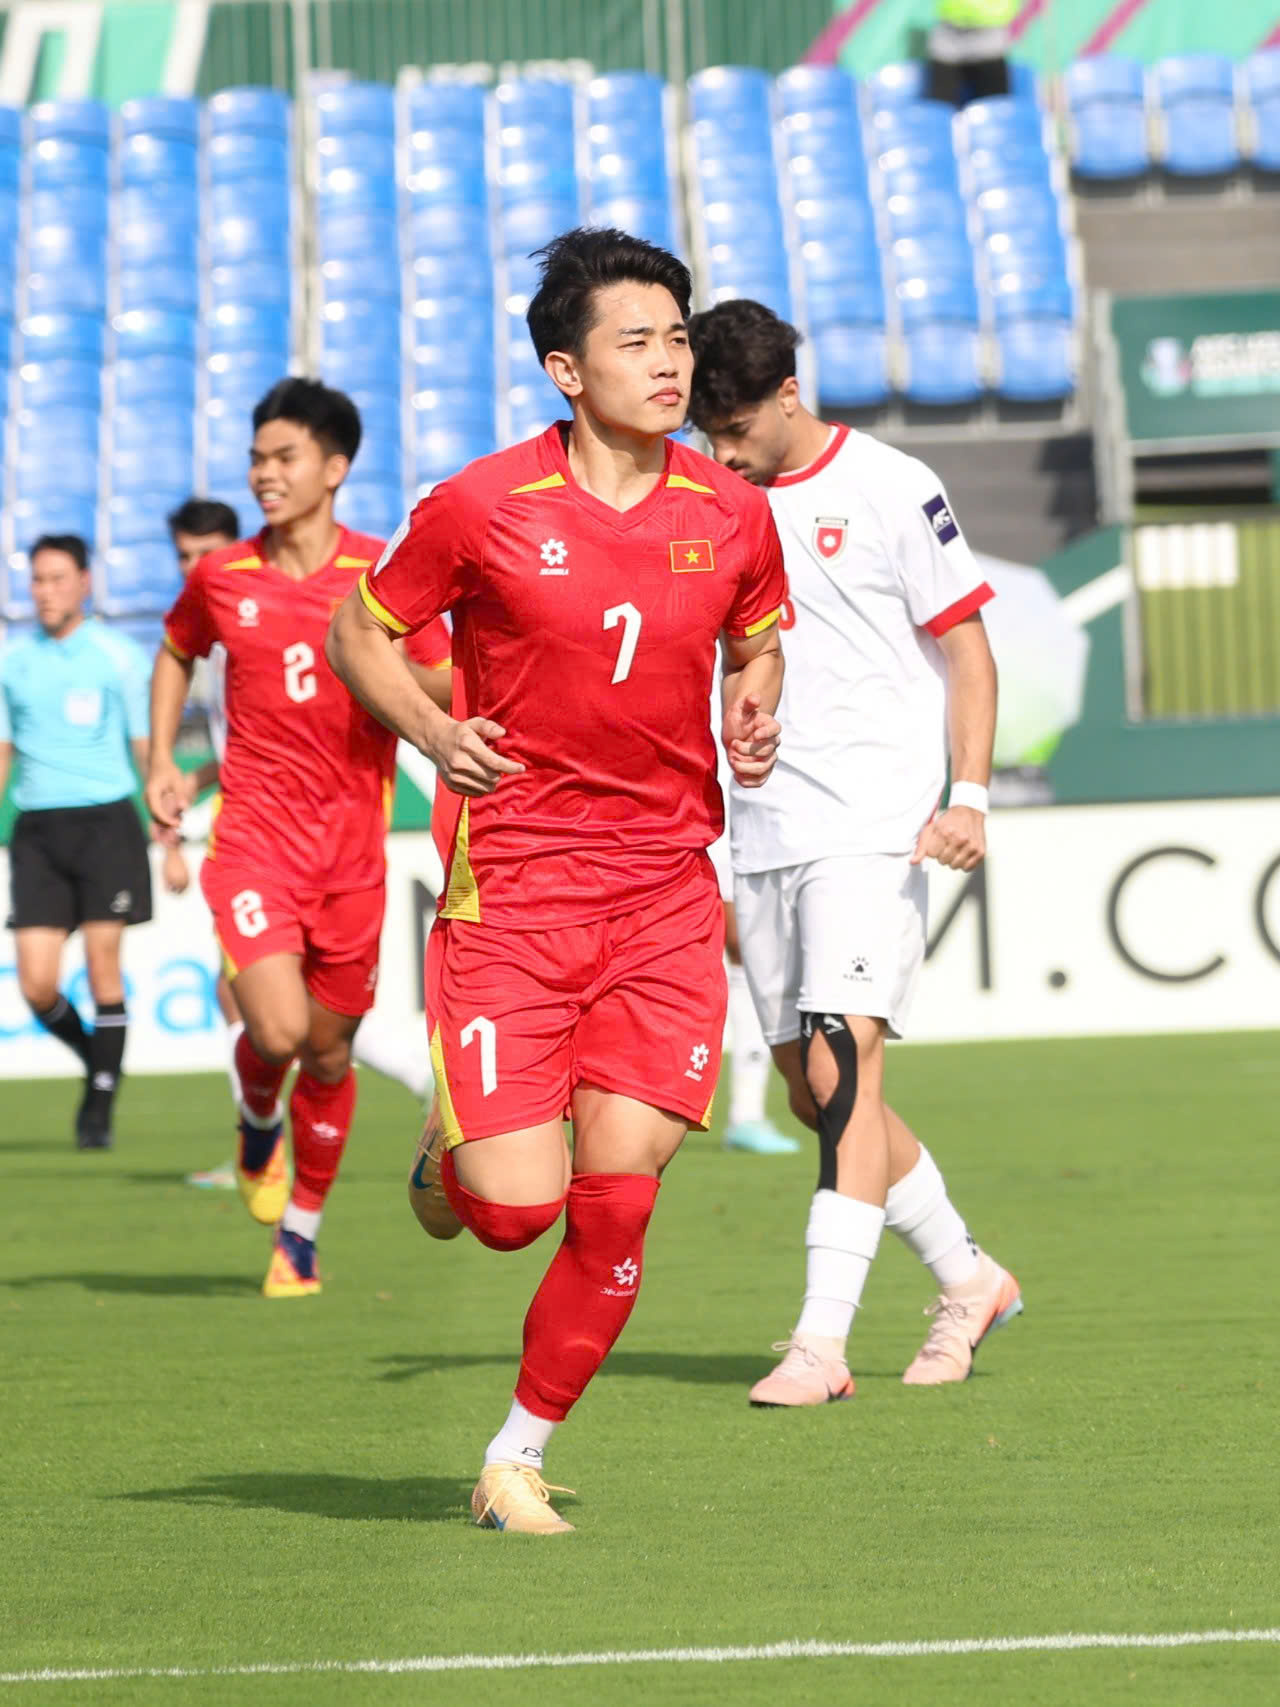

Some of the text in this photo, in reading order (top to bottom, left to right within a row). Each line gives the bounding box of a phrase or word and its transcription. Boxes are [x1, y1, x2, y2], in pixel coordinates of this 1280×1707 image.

[283, 641, 317, 703] 2
[602, 601, 643, 686] 7
[230, 888, 268, 938] 2
[460, 1015, 497, 1097] 7
